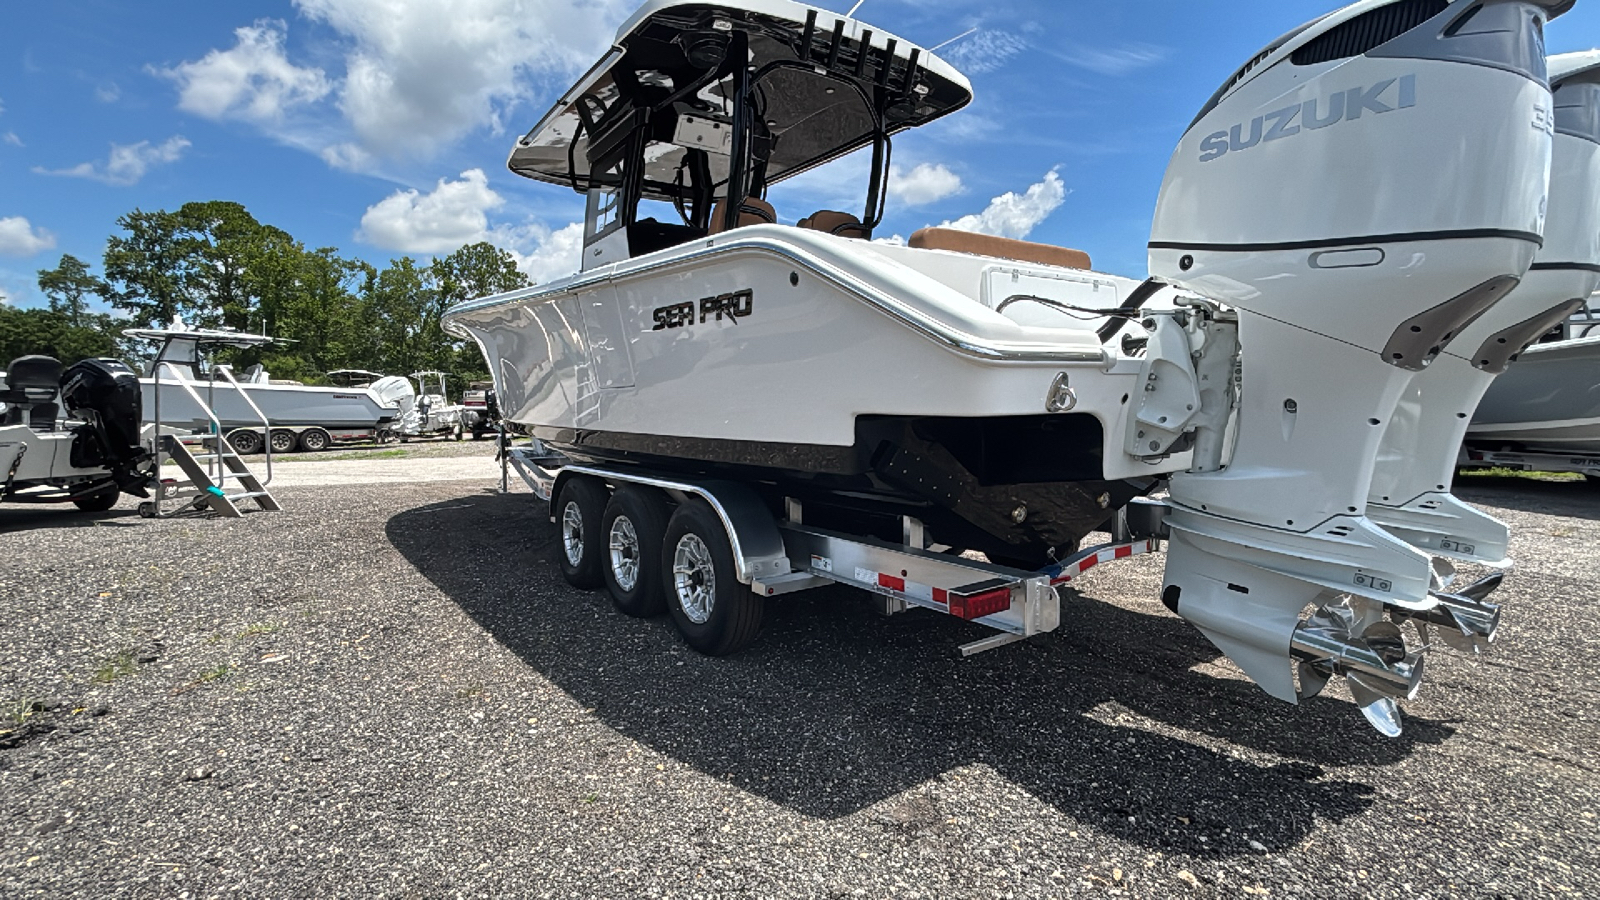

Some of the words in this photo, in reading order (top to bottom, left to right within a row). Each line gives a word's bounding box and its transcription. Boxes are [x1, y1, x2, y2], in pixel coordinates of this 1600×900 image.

[1199, 73, 1416, 162] SUZUKI
[652, 301, 695, 331] SEA
[699, 288, 754, 326] PRO
